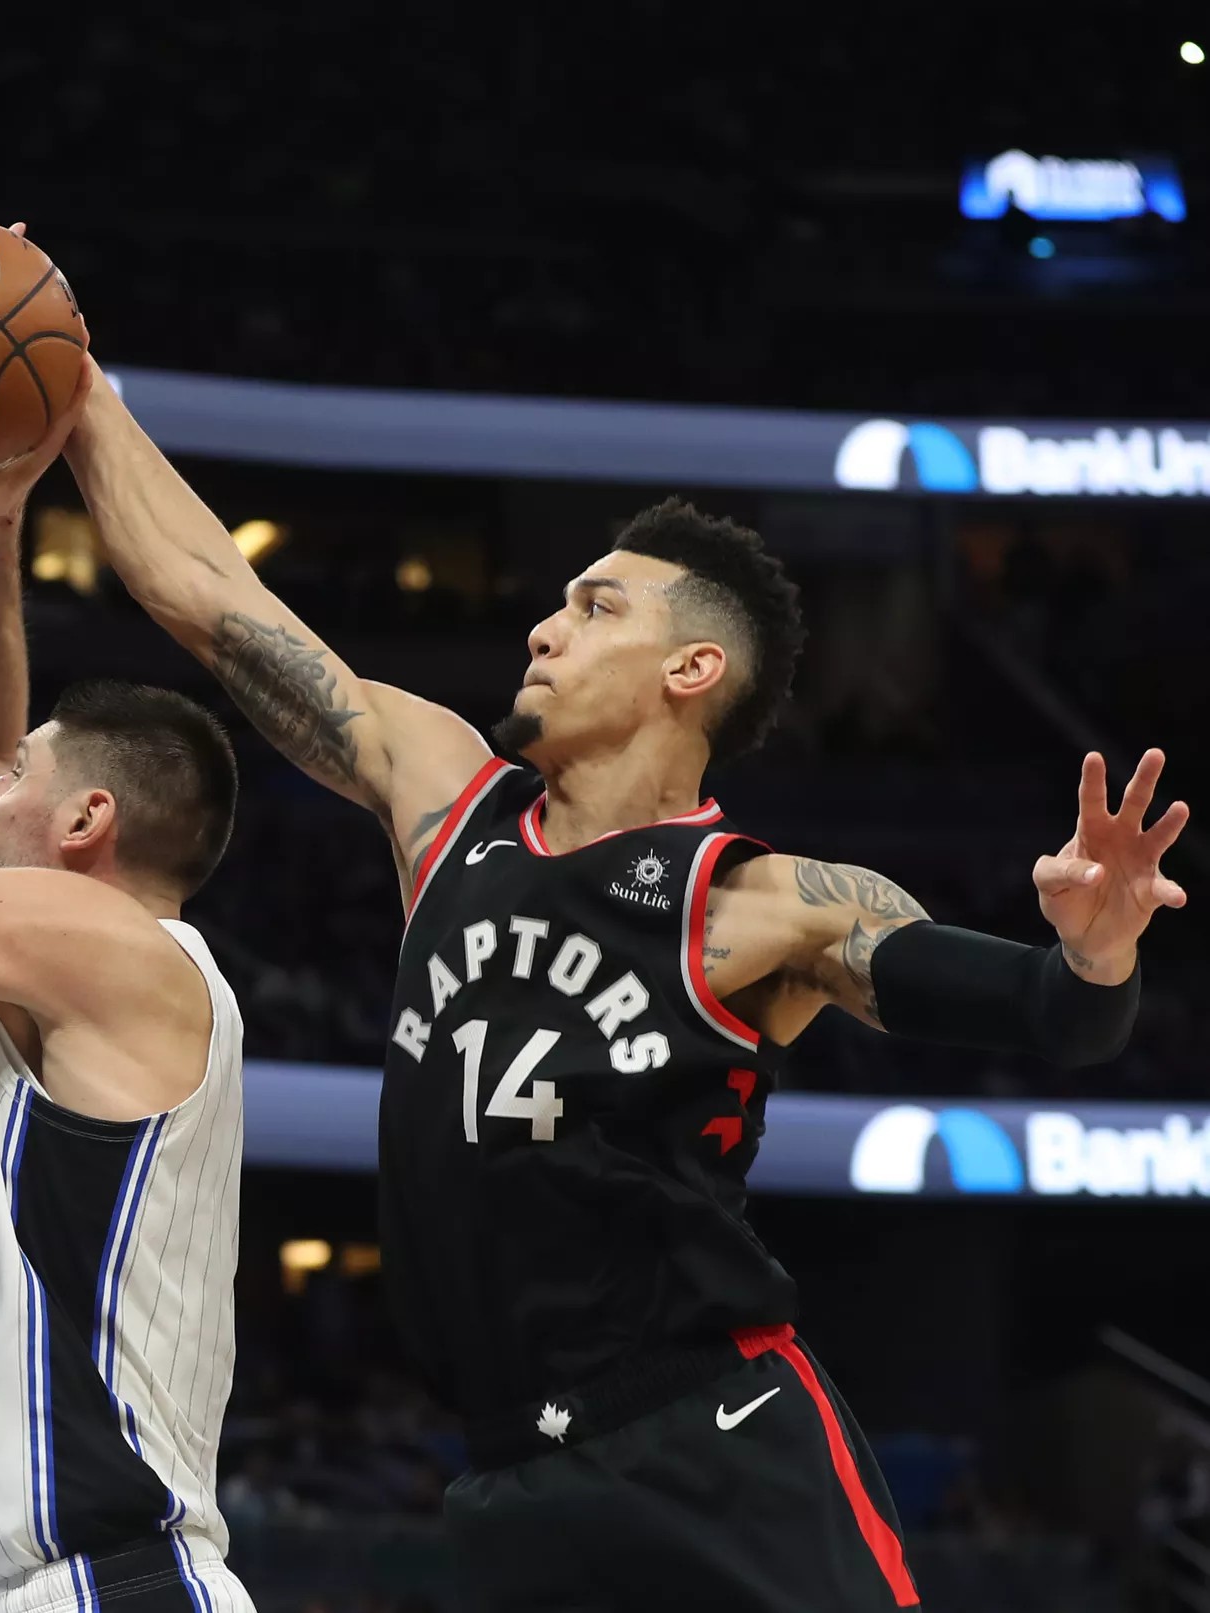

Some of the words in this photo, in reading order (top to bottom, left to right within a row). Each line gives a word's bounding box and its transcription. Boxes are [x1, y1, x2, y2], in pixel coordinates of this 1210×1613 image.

[978, 426, 1210, 496] BankUn
[609, 881, 639, 902] Sun
[642, 891, 671, 910] Life
[392, 914, 671, 1074] RAPTORS
[451, 1019, 563, 1144] 14
[1026, 1111, 1210, 1197] Bank
